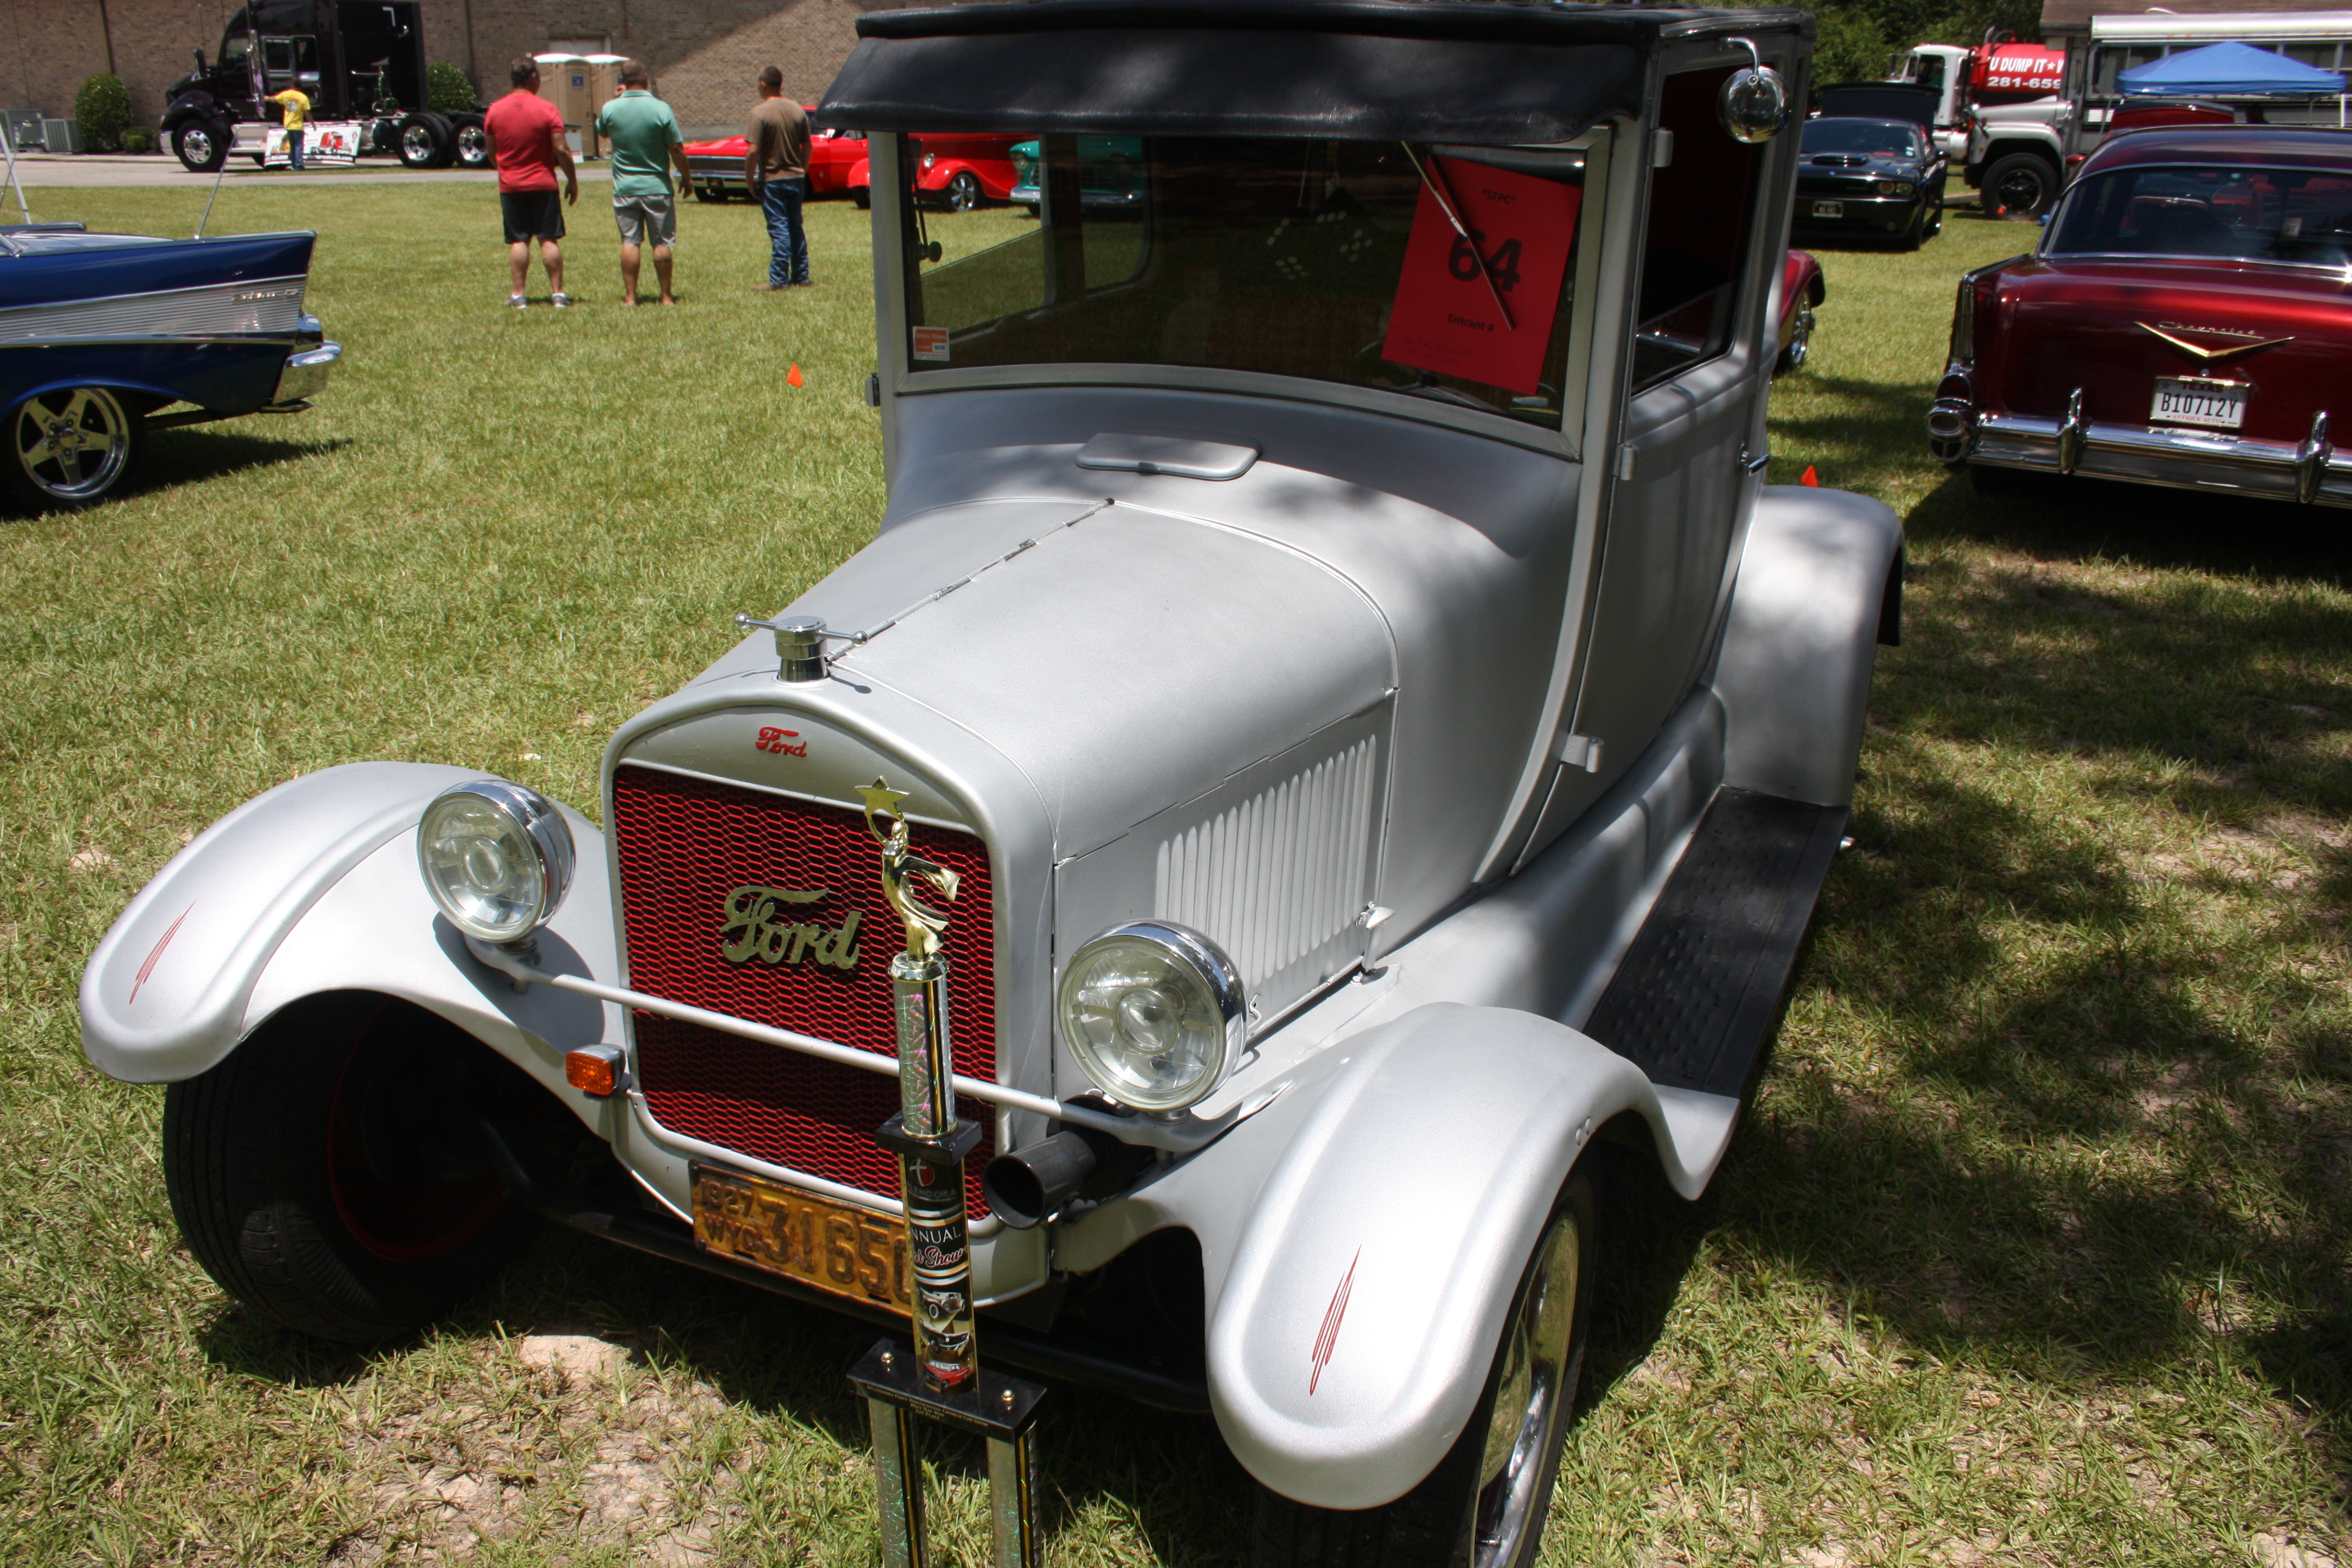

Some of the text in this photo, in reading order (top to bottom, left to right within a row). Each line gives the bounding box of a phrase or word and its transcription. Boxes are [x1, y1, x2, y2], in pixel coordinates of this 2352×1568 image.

[2000, 57, 2033, 73] DUMP
[2033, 58, 2048, 73] IT
[1987, 76, 2061, 89] 281-659
[1448, 227, 1522, 292] 64
[1447, 313, 1486, 330] Entrant
[2158, 321, 2264, 339] Chevrolet
[2182, 382, 2224, 393] TEXAS
[2161, 393, 2237, 418] B10712Y
[755, 726, 807, 758] Ford
[719, 885, 862, 970] Ford
[699, 1177, 755, 1218] 1927
[924, 1245, 963, 1268] Show
